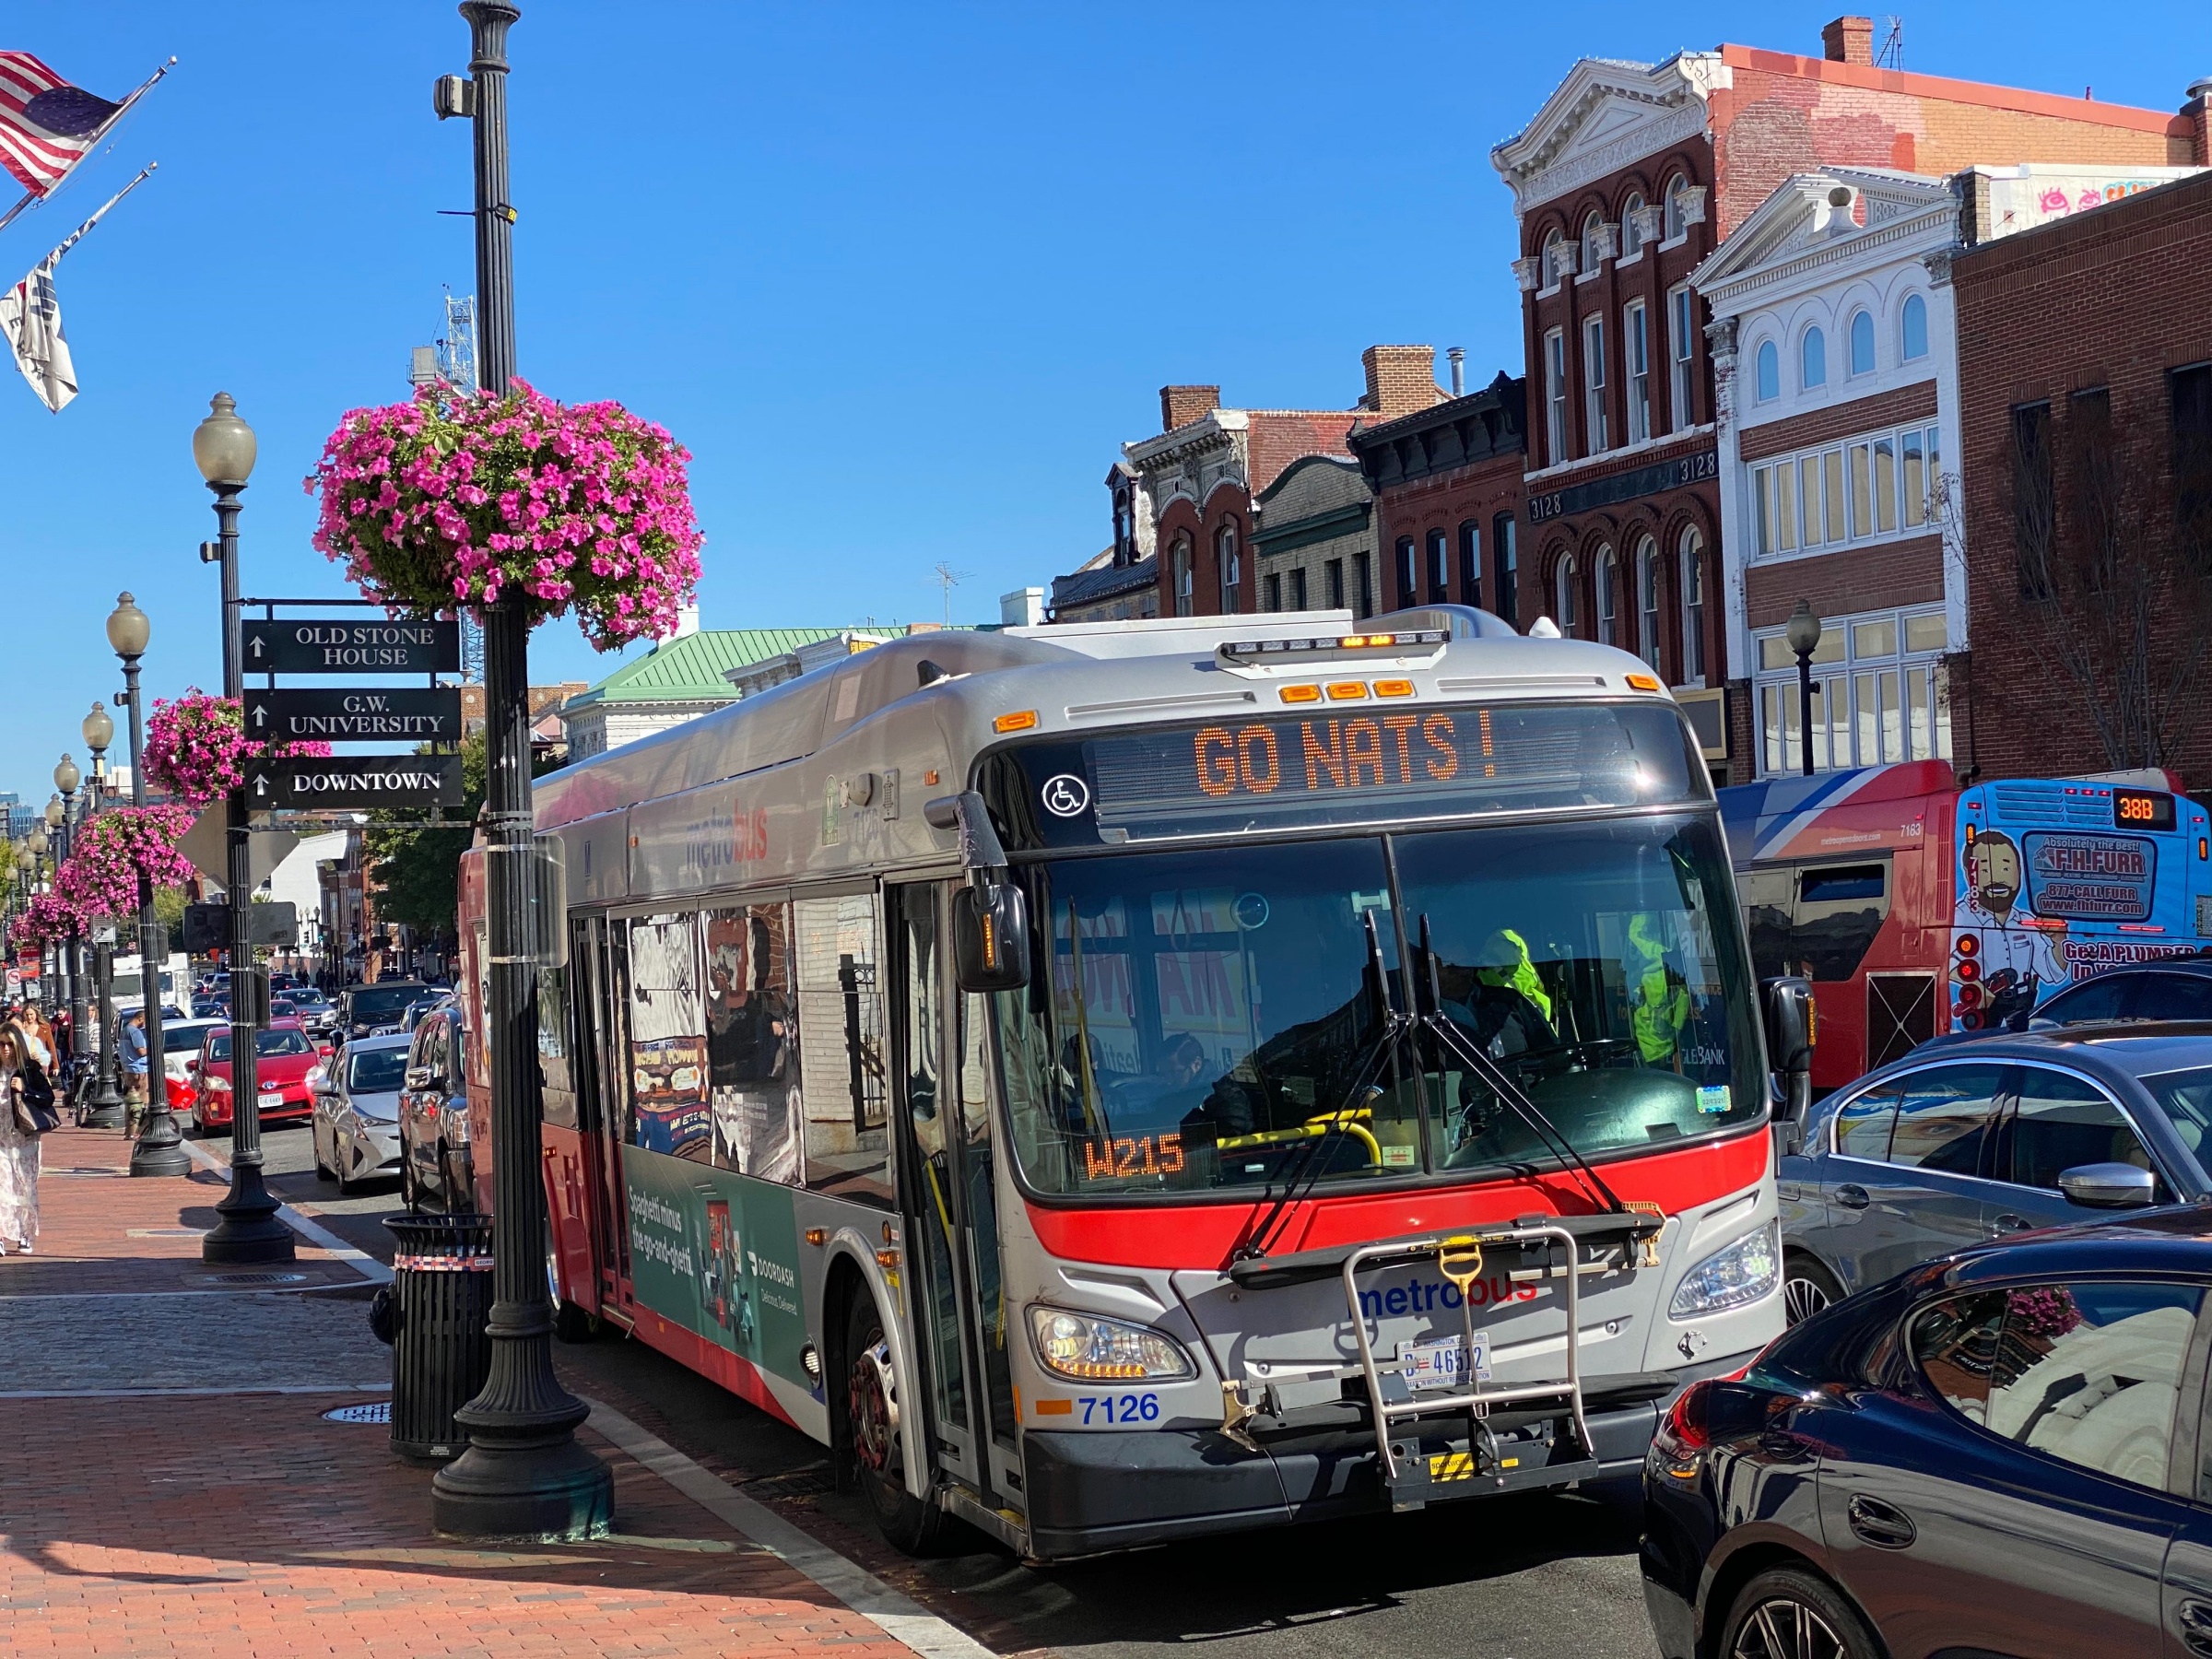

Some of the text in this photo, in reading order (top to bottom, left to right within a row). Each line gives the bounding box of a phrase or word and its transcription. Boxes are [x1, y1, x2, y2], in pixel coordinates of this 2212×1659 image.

[1680, 453, 1715, 481] 3128
[1531, 494, 1561, 519] 3128
[295, 627, 434, 644] OLD STONE
[323, 648, 408, 665] HOUSE
[343, 696, 390, 712] G.W.
[289, 715, 445, 734] UNIVERSITY
[1194, 724, 1280, 797] GO
[293, 771, 441, 792] DOWNTOWN
[2120, 797, 2153, 819] 38B
[686, 798, 768, 870] metrobus
[1900, 823, 1921, 837] 7183
[2043, 837, 2139, 852] Absolutely the Best!
[1970, 856, 1980, 913] 7183
[2047, 885, 2136, 900] 877-CALL FURR
[2041, 899, 2143, 915] www.fhfurr.com
[2065, 943, 2097, 960] Get
[2099, 943, 2112, 961] A
[1086, 1134, 1184, 1181] W215
[629, 1185, 682, 1233] Spaghetti minus
[632, 1222, 644, 1253] the
[759, 1257, 794, 1288] DOORDASH
[1078, 1394, 1159, 1425] 7126
